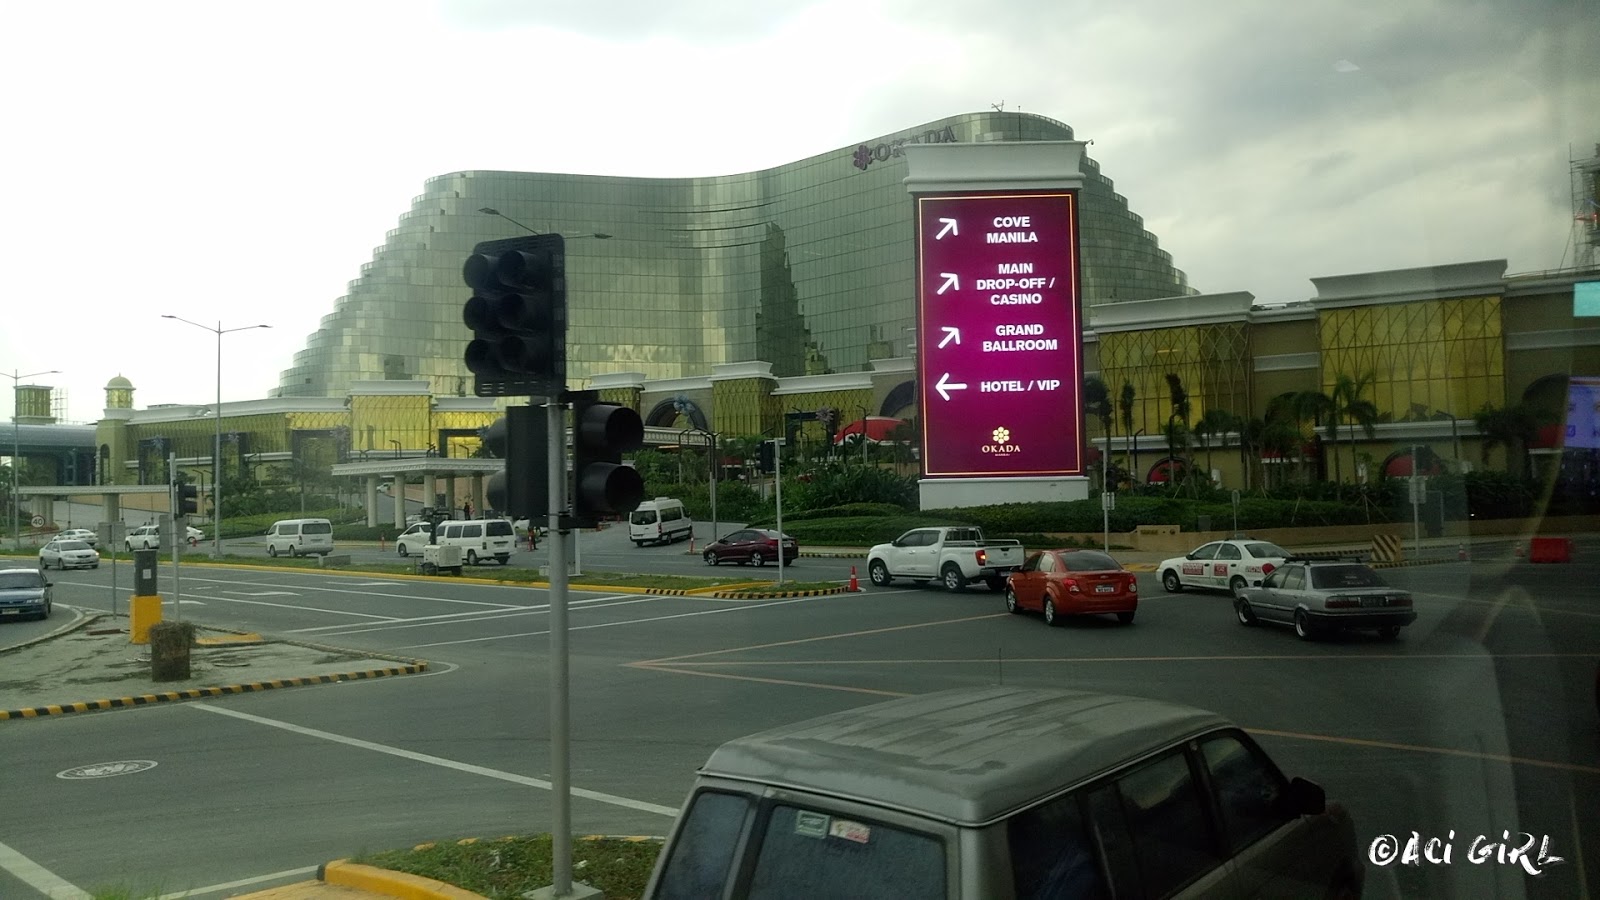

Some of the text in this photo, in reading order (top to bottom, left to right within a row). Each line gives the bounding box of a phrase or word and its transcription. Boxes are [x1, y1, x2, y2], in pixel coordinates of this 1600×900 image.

[993, 216, 1031, 228] COVE
[986, 231, 1039, 244] MANILA
[998, 262, 1034, 275] MAIN
[976, 277, 1047, 291] DROP-OFF
[990, 293, 1043, 306] CASINO
[995, 324, 1044, 336] GRAND
[982, 338, 1058, 352] BALLROOM
[980, 379, 1025, 393] HOTEL
[1036, 379, 1061, 391] VIP
[981, 444, 1021, 453] OKADA
[32, 518, 43, 526] 40
